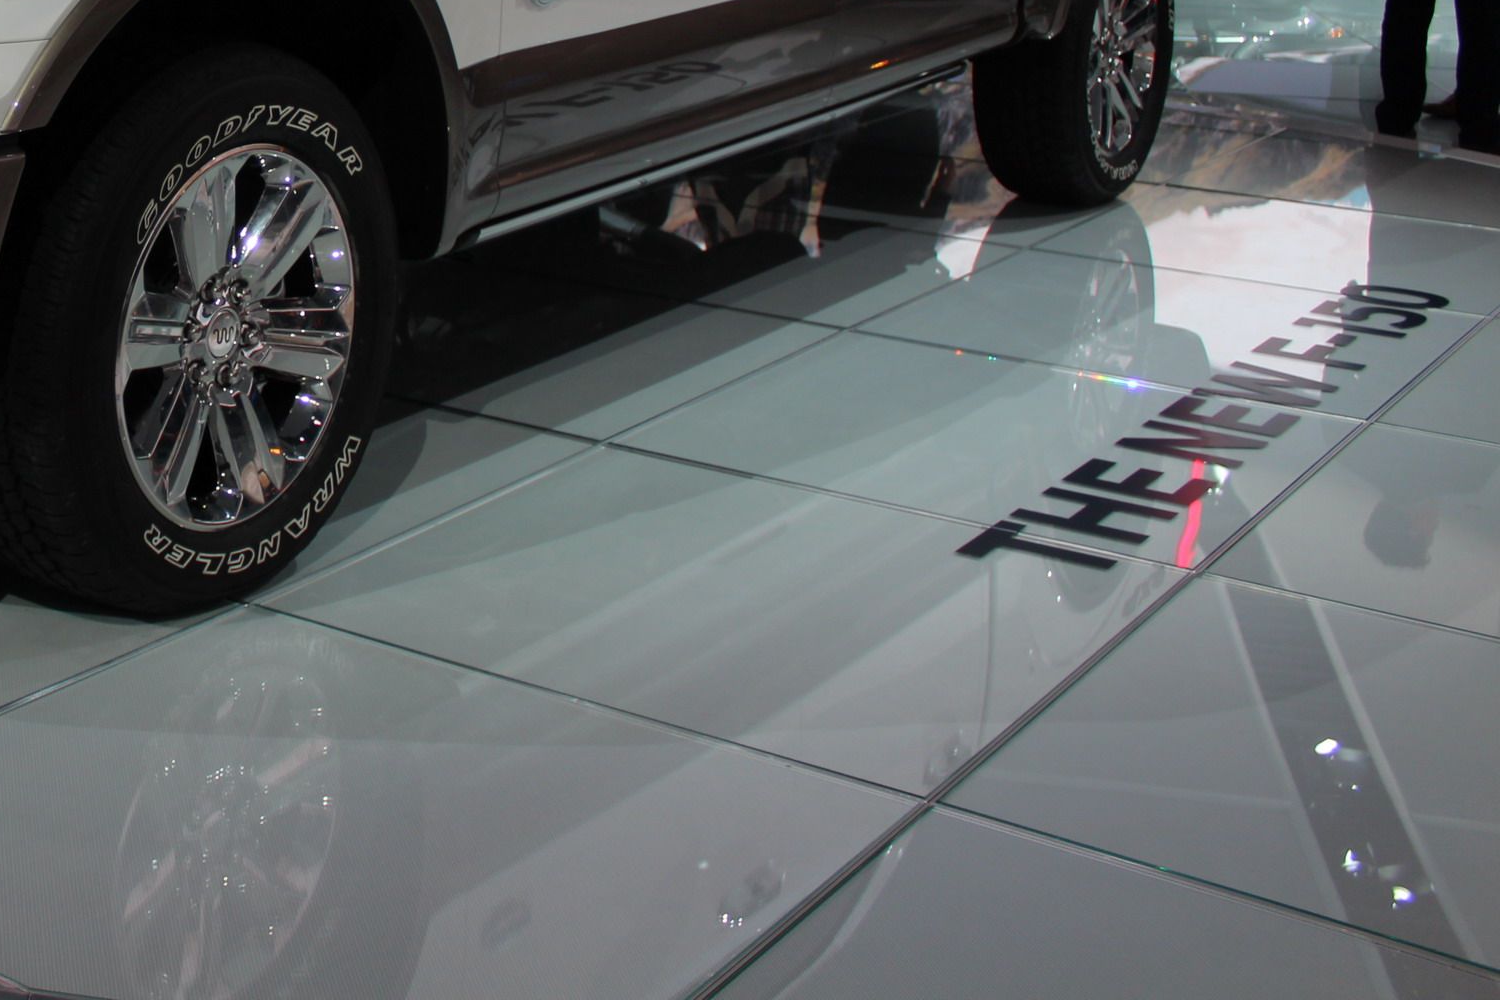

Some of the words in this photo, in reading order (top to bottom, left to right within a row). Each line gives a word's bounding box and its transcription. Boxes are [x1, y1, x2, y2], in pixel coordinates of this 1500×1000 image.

[137, 105, 363, 245] GOODYEAR
[955, 457, 1218, 570] THE
[1114, 360, 1339, 470] NEW
[1251, 284, 1450, 370] F-150
[143, 435, 361, 575] WRANGLER
